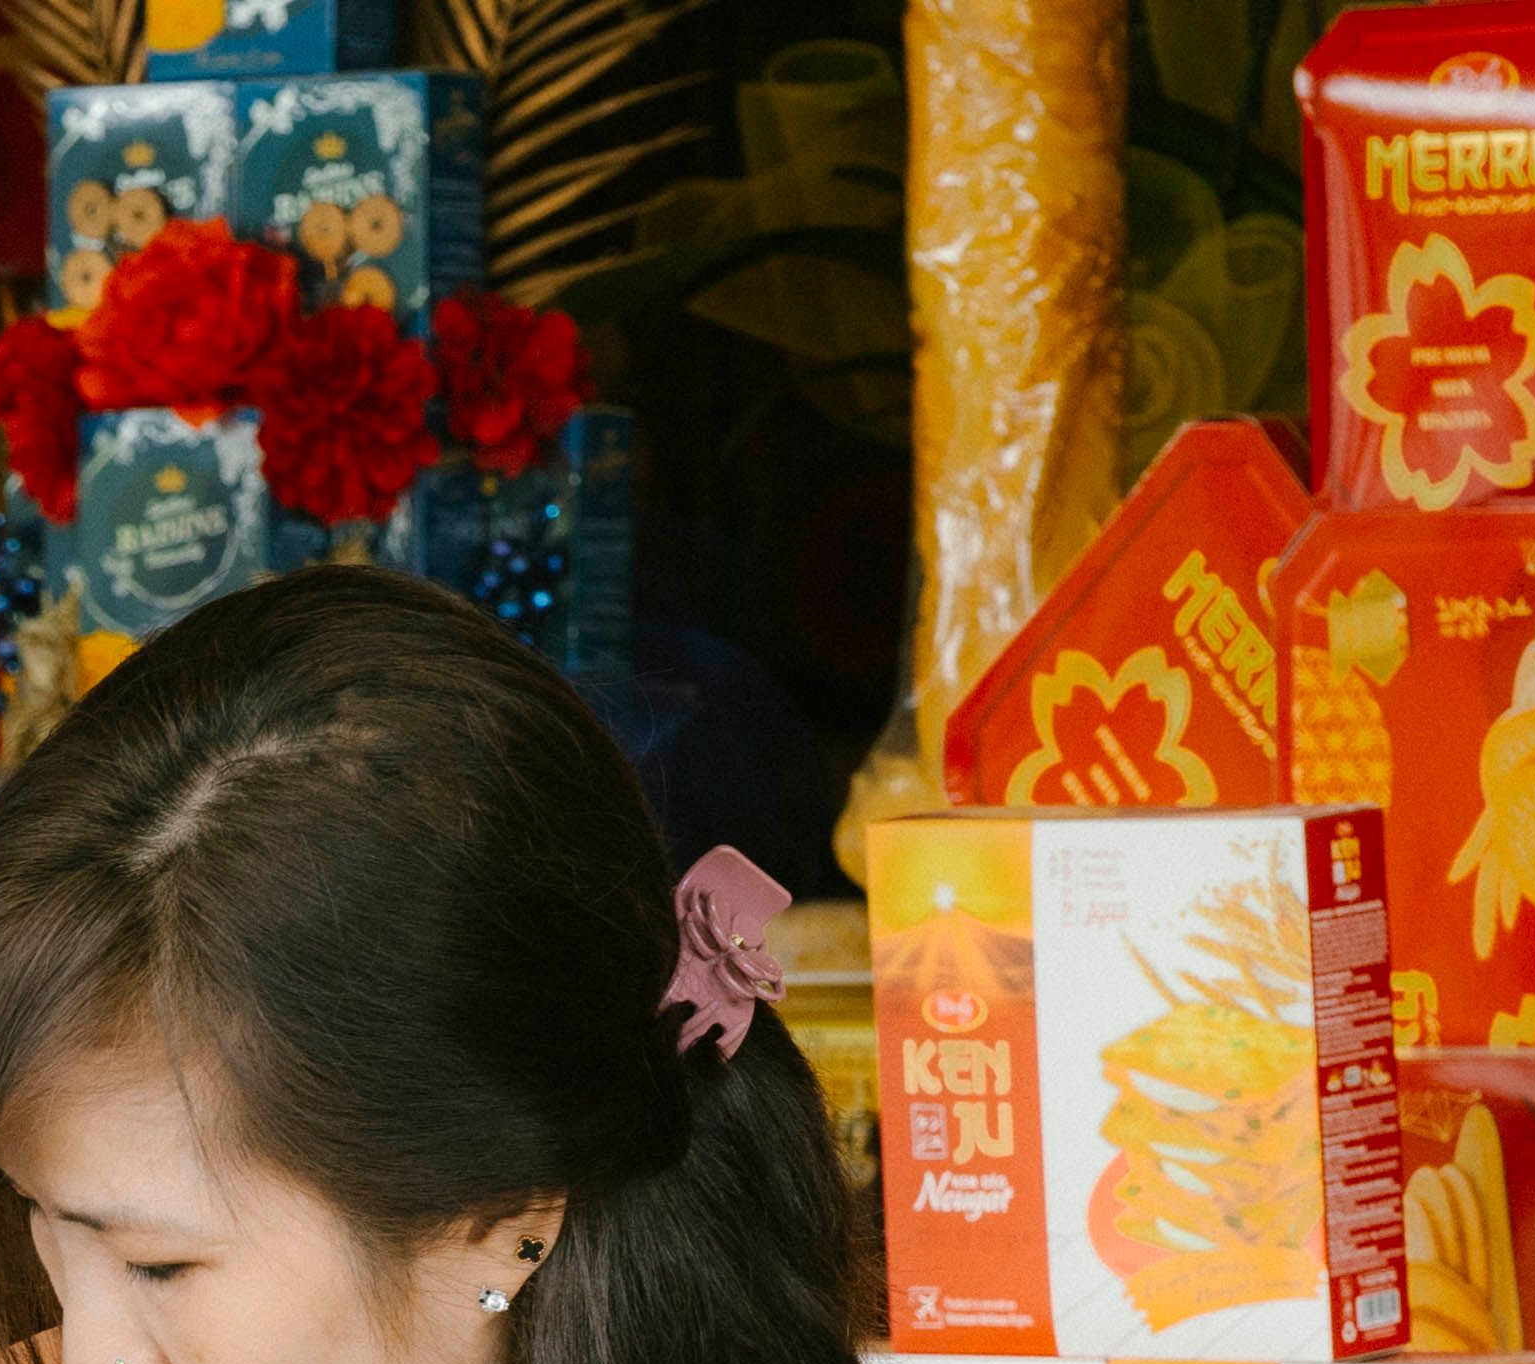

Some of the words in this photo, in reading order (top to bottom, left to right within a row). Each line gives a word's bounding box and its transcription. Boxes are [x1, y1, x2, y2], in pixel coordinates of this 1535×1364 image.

[1162, 549, 1276, 727] MER
[902, 1038, 1011, 1096] KEN
[952, 1100, 1015, 1166] JU
